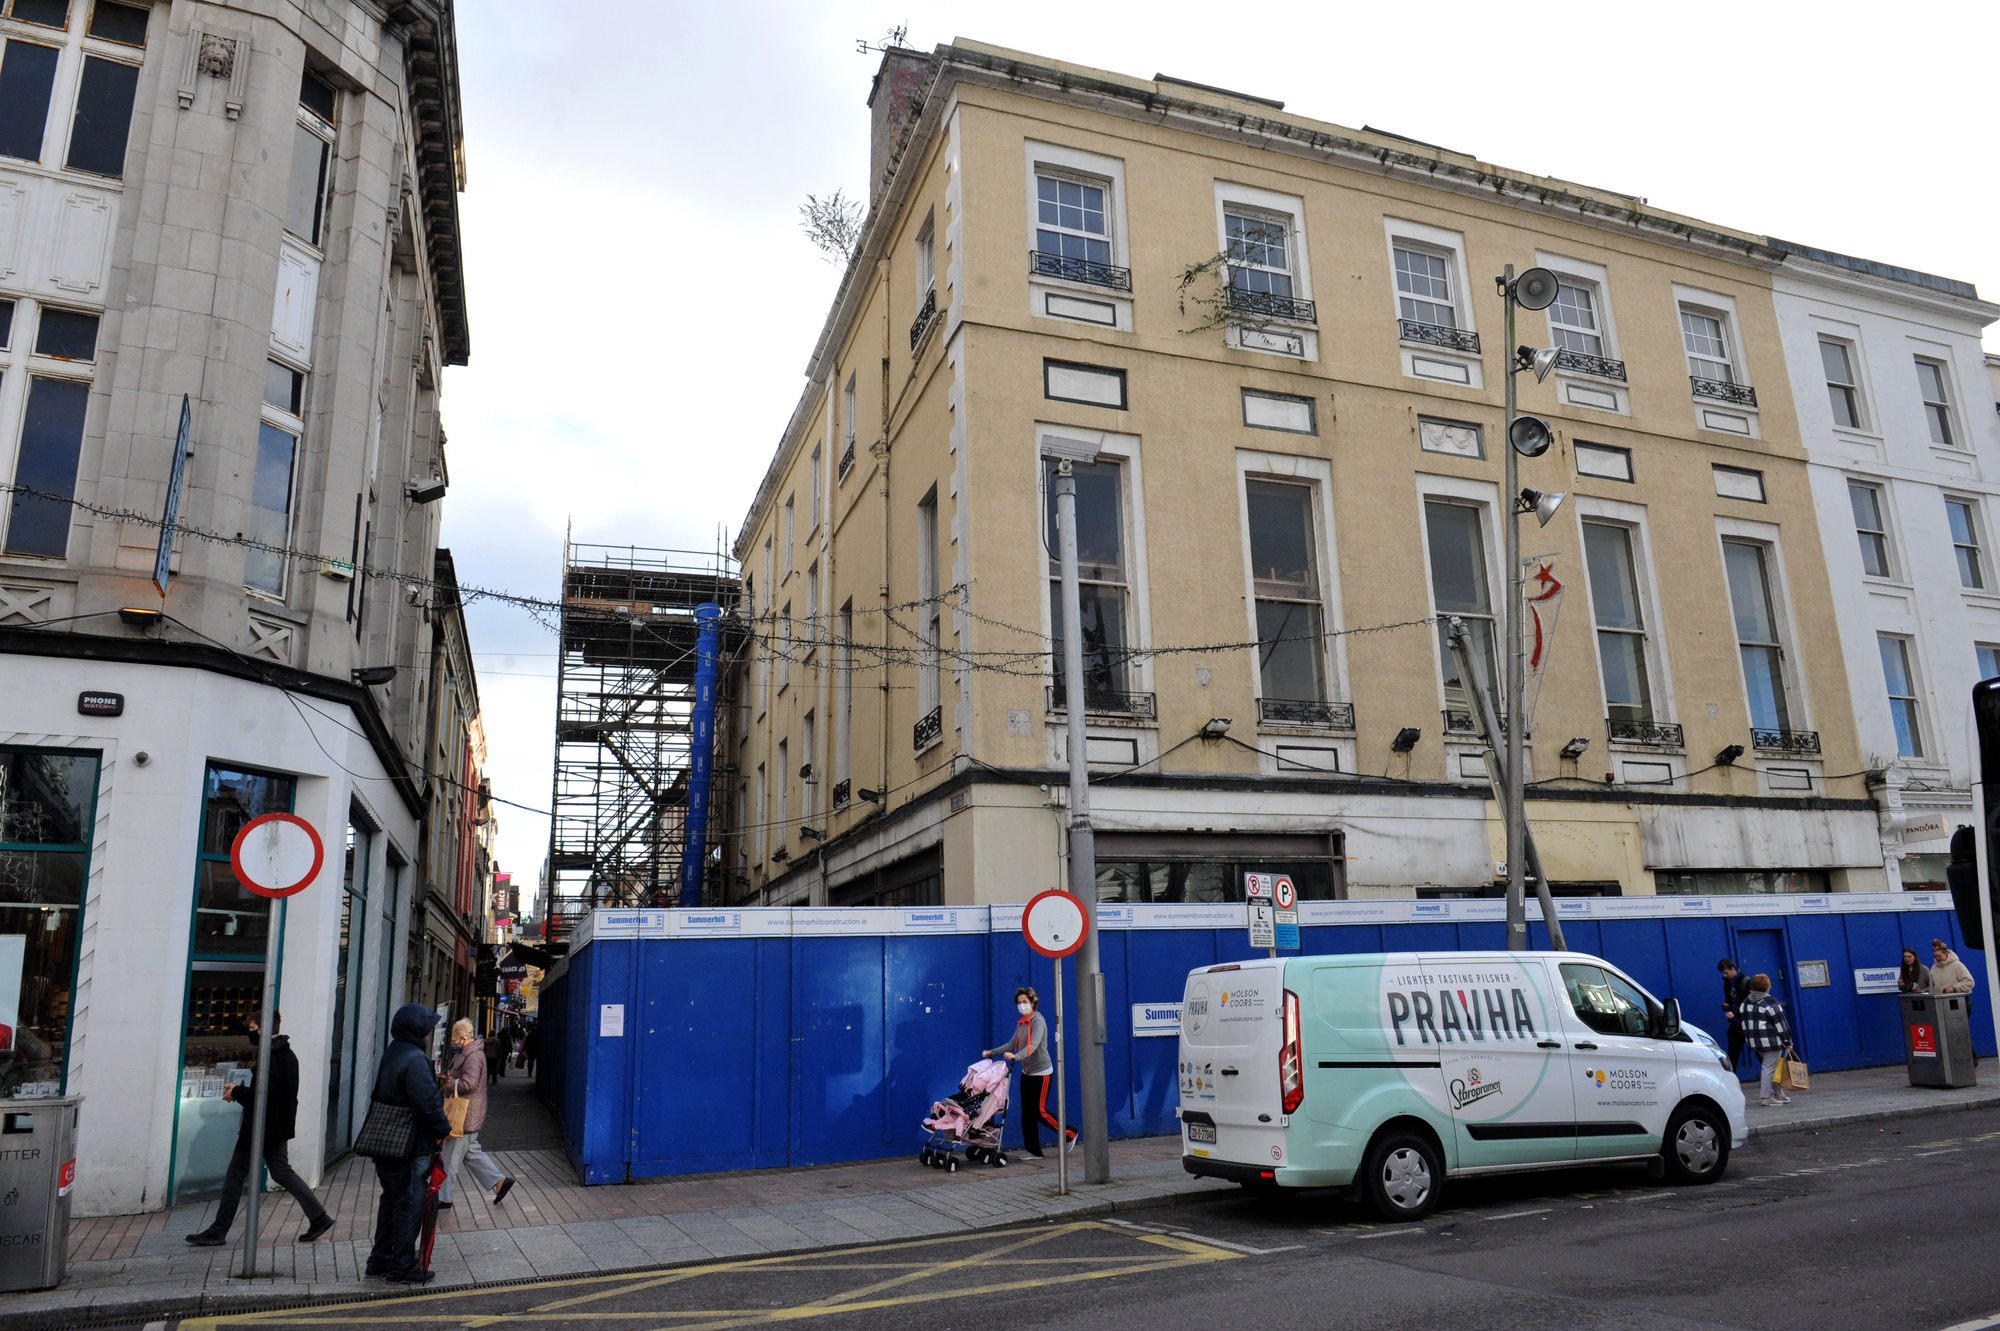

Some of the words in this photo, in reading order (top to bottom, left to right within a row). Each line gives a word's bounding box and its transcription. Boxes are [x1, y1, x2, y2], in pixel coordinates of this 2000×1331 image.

[84, 697, 116, 705] PHONE
[1282, 885, 1289, 902] P
[767, 918, 868, 926] www.summerhillconstruction.ie
[1397, 975, 1434, 985] LIGHTER
[1438, 974, 1473, 984] TASTING
[1477, 974, 1511, 983] PILSNER
[1862, 972, 1895, 981] Summerhill
[1231, 990, 1258, 998] MOLSON
[1230, 999, 1252, 1007] COORS
[1189, 1001, 1207, 1015] PRAVHA
[1387, 988, 1539, 1046] PRAVHA
[1610, 1070, 1647, 1078] MOLSON
[1611, 1081, 1641, 1089] COORS
[1450, 1079, 1501, 1110] Staropramen
